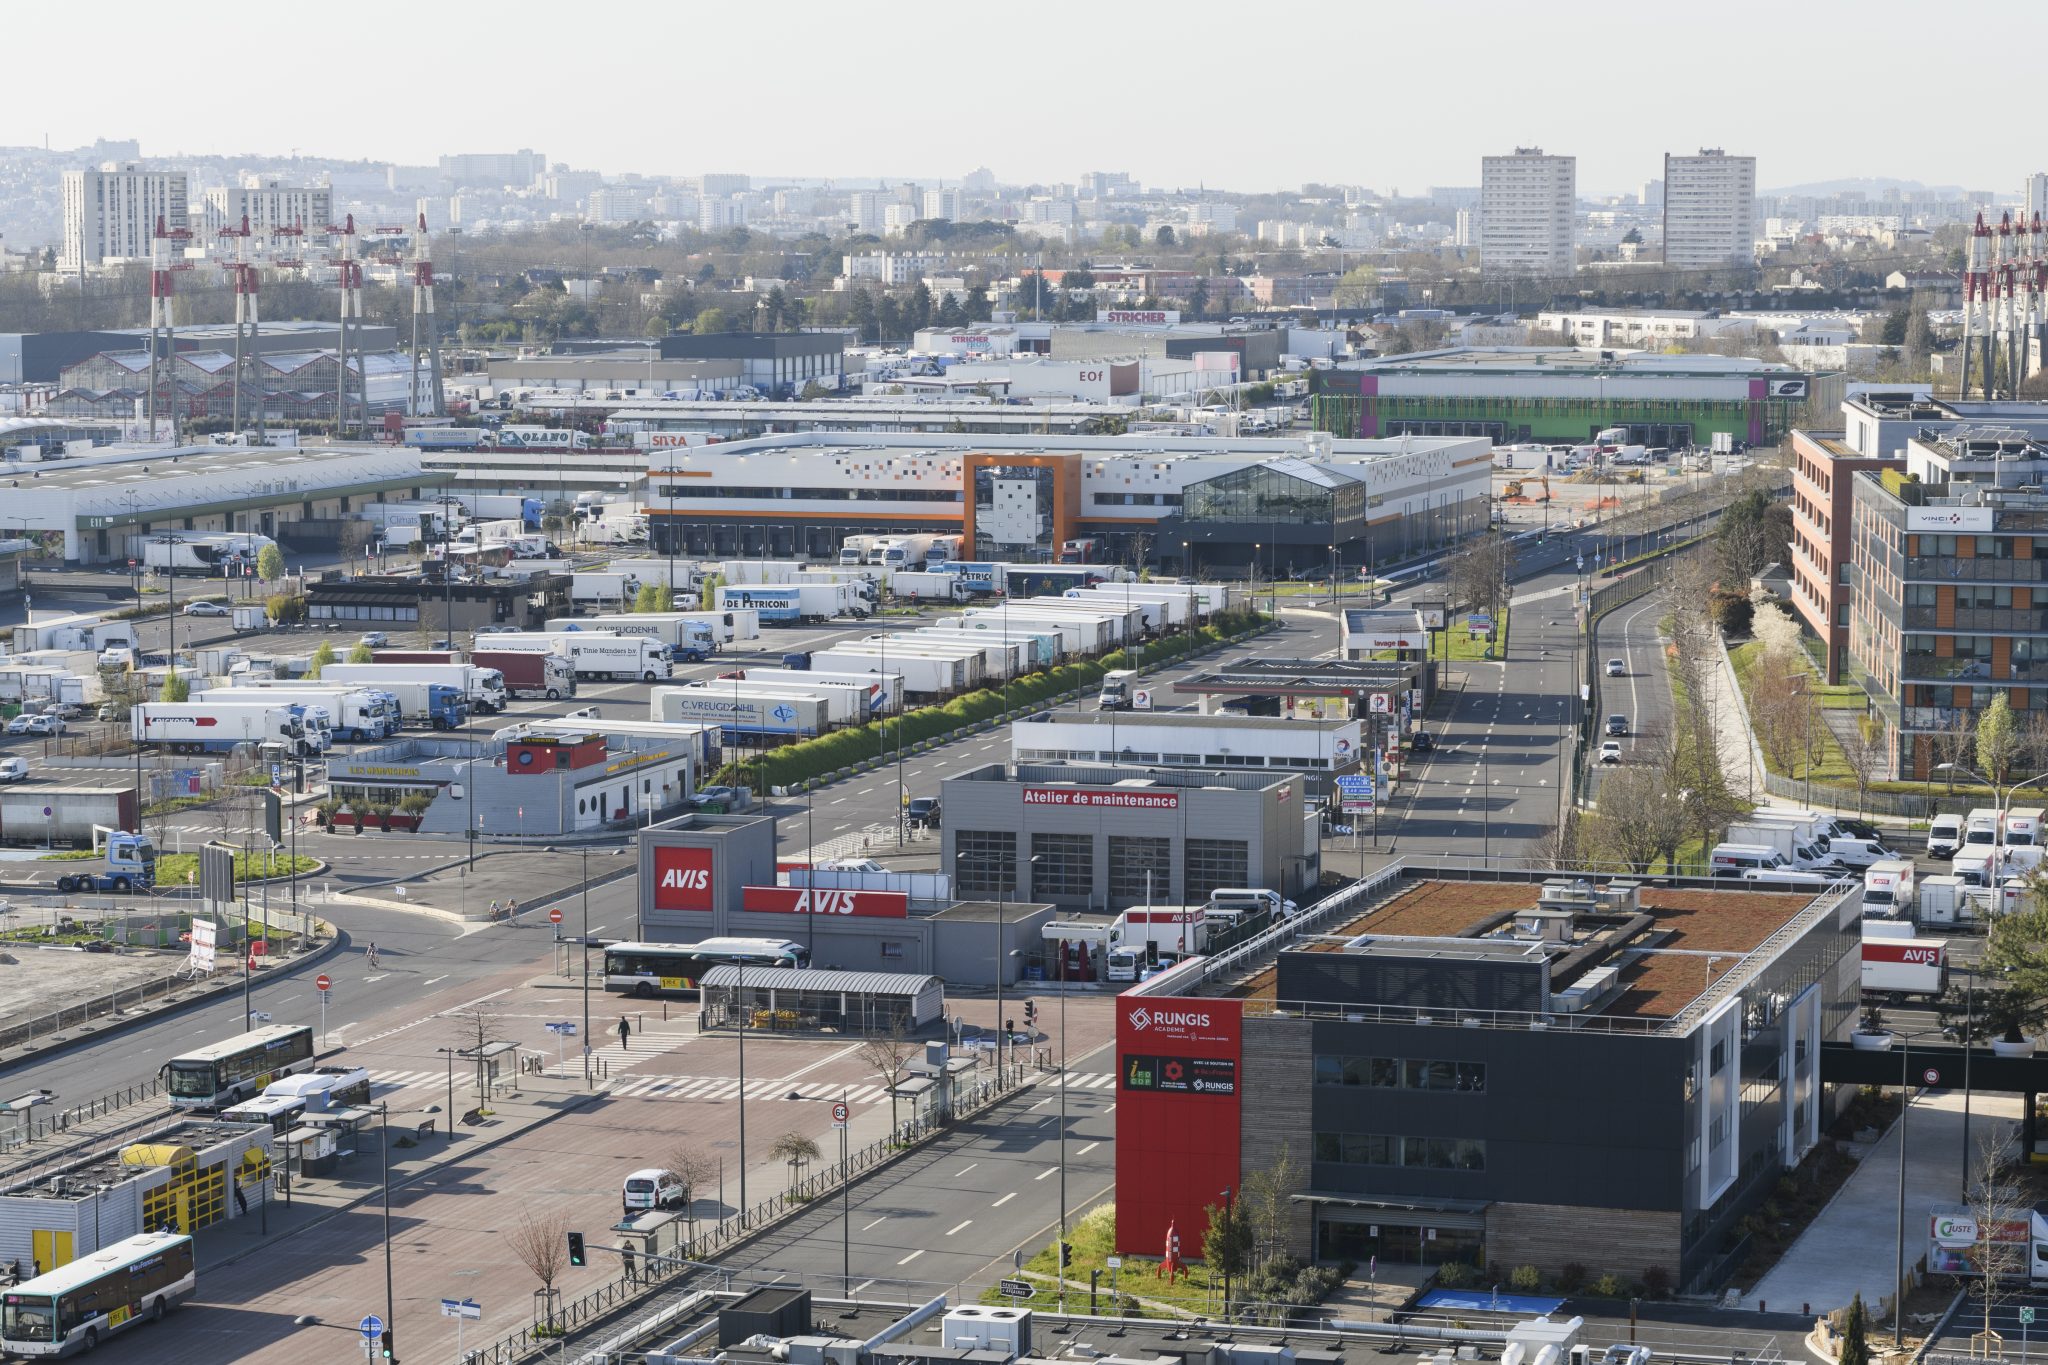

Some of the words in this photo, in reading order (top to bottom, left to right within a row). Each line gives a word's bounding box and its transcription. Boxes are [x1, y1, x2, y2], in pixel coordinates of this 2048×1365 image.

[1107, 311, 1166, 323] STRICHER
[951, 336, 989, 344] STRICHER
[522, 432, 569, 442] OLANO
[652, 435, 688, 446] SITRA
[726, 600, 738, 608] DE
[1374, 640, 1396, 648] lavage
[1024, 790, 1069, 803] Atelier
[1072, 792, 1088, 804] de
[1092, 794, 1177, 808] maintenance
[661, 868, 709, 890] AVIS
[794, 890, 858, 915] AVIS
[1172, 914, 1191, 922] AVS
[1902, 950, 1936, 962] AVIS
[1154, 1011, 1210, 1027] RUNGIS
[1205, 1082, 1234, 1090] RUNGIS
[836, 1108, 846, 1116] 60
